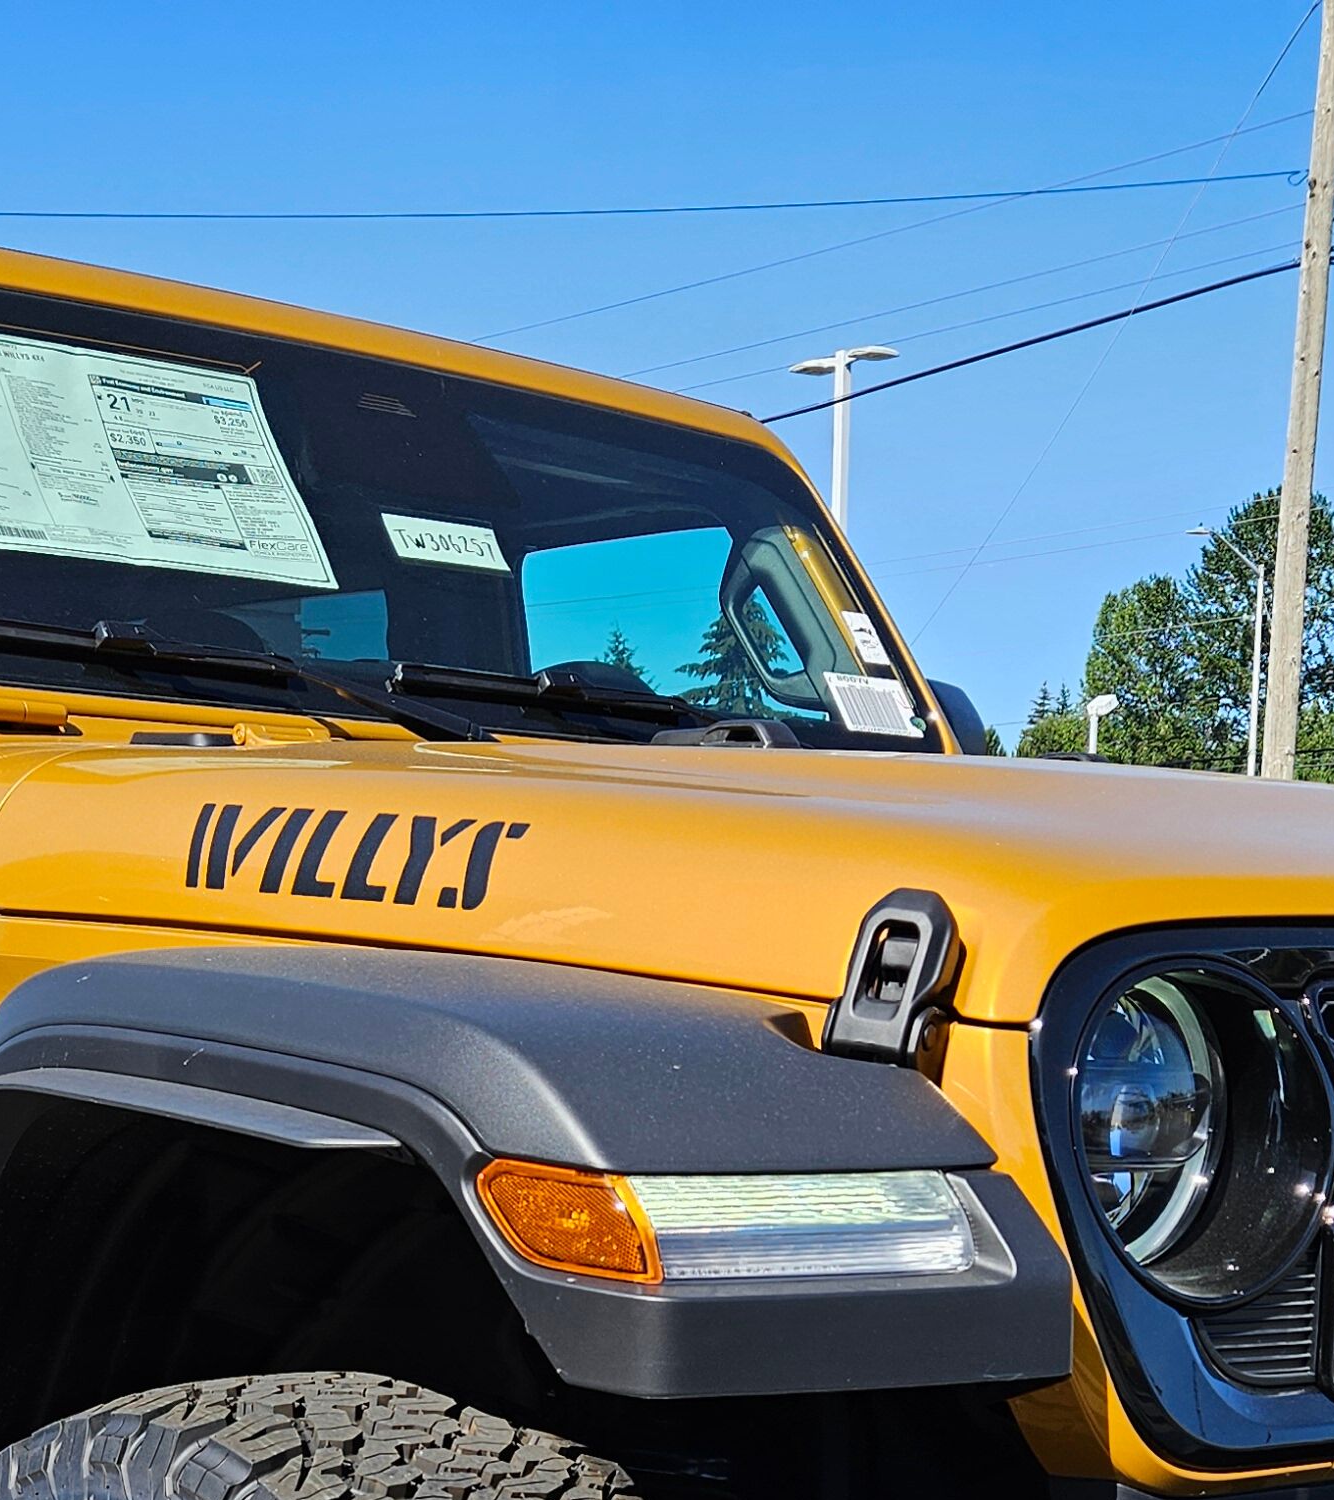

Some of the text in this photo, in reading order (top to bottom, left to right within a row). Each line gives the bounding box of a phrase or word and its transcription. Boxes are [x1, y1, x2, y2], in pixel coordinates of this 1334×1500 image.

[107, 393, 131, 412] 21
[213, 415, 248, 429] $3,250
[109, 433, 146, 447] $2,350
[249, 539, 309, 552] FlexCare
[184, 803, 531, 911] WILLYS
